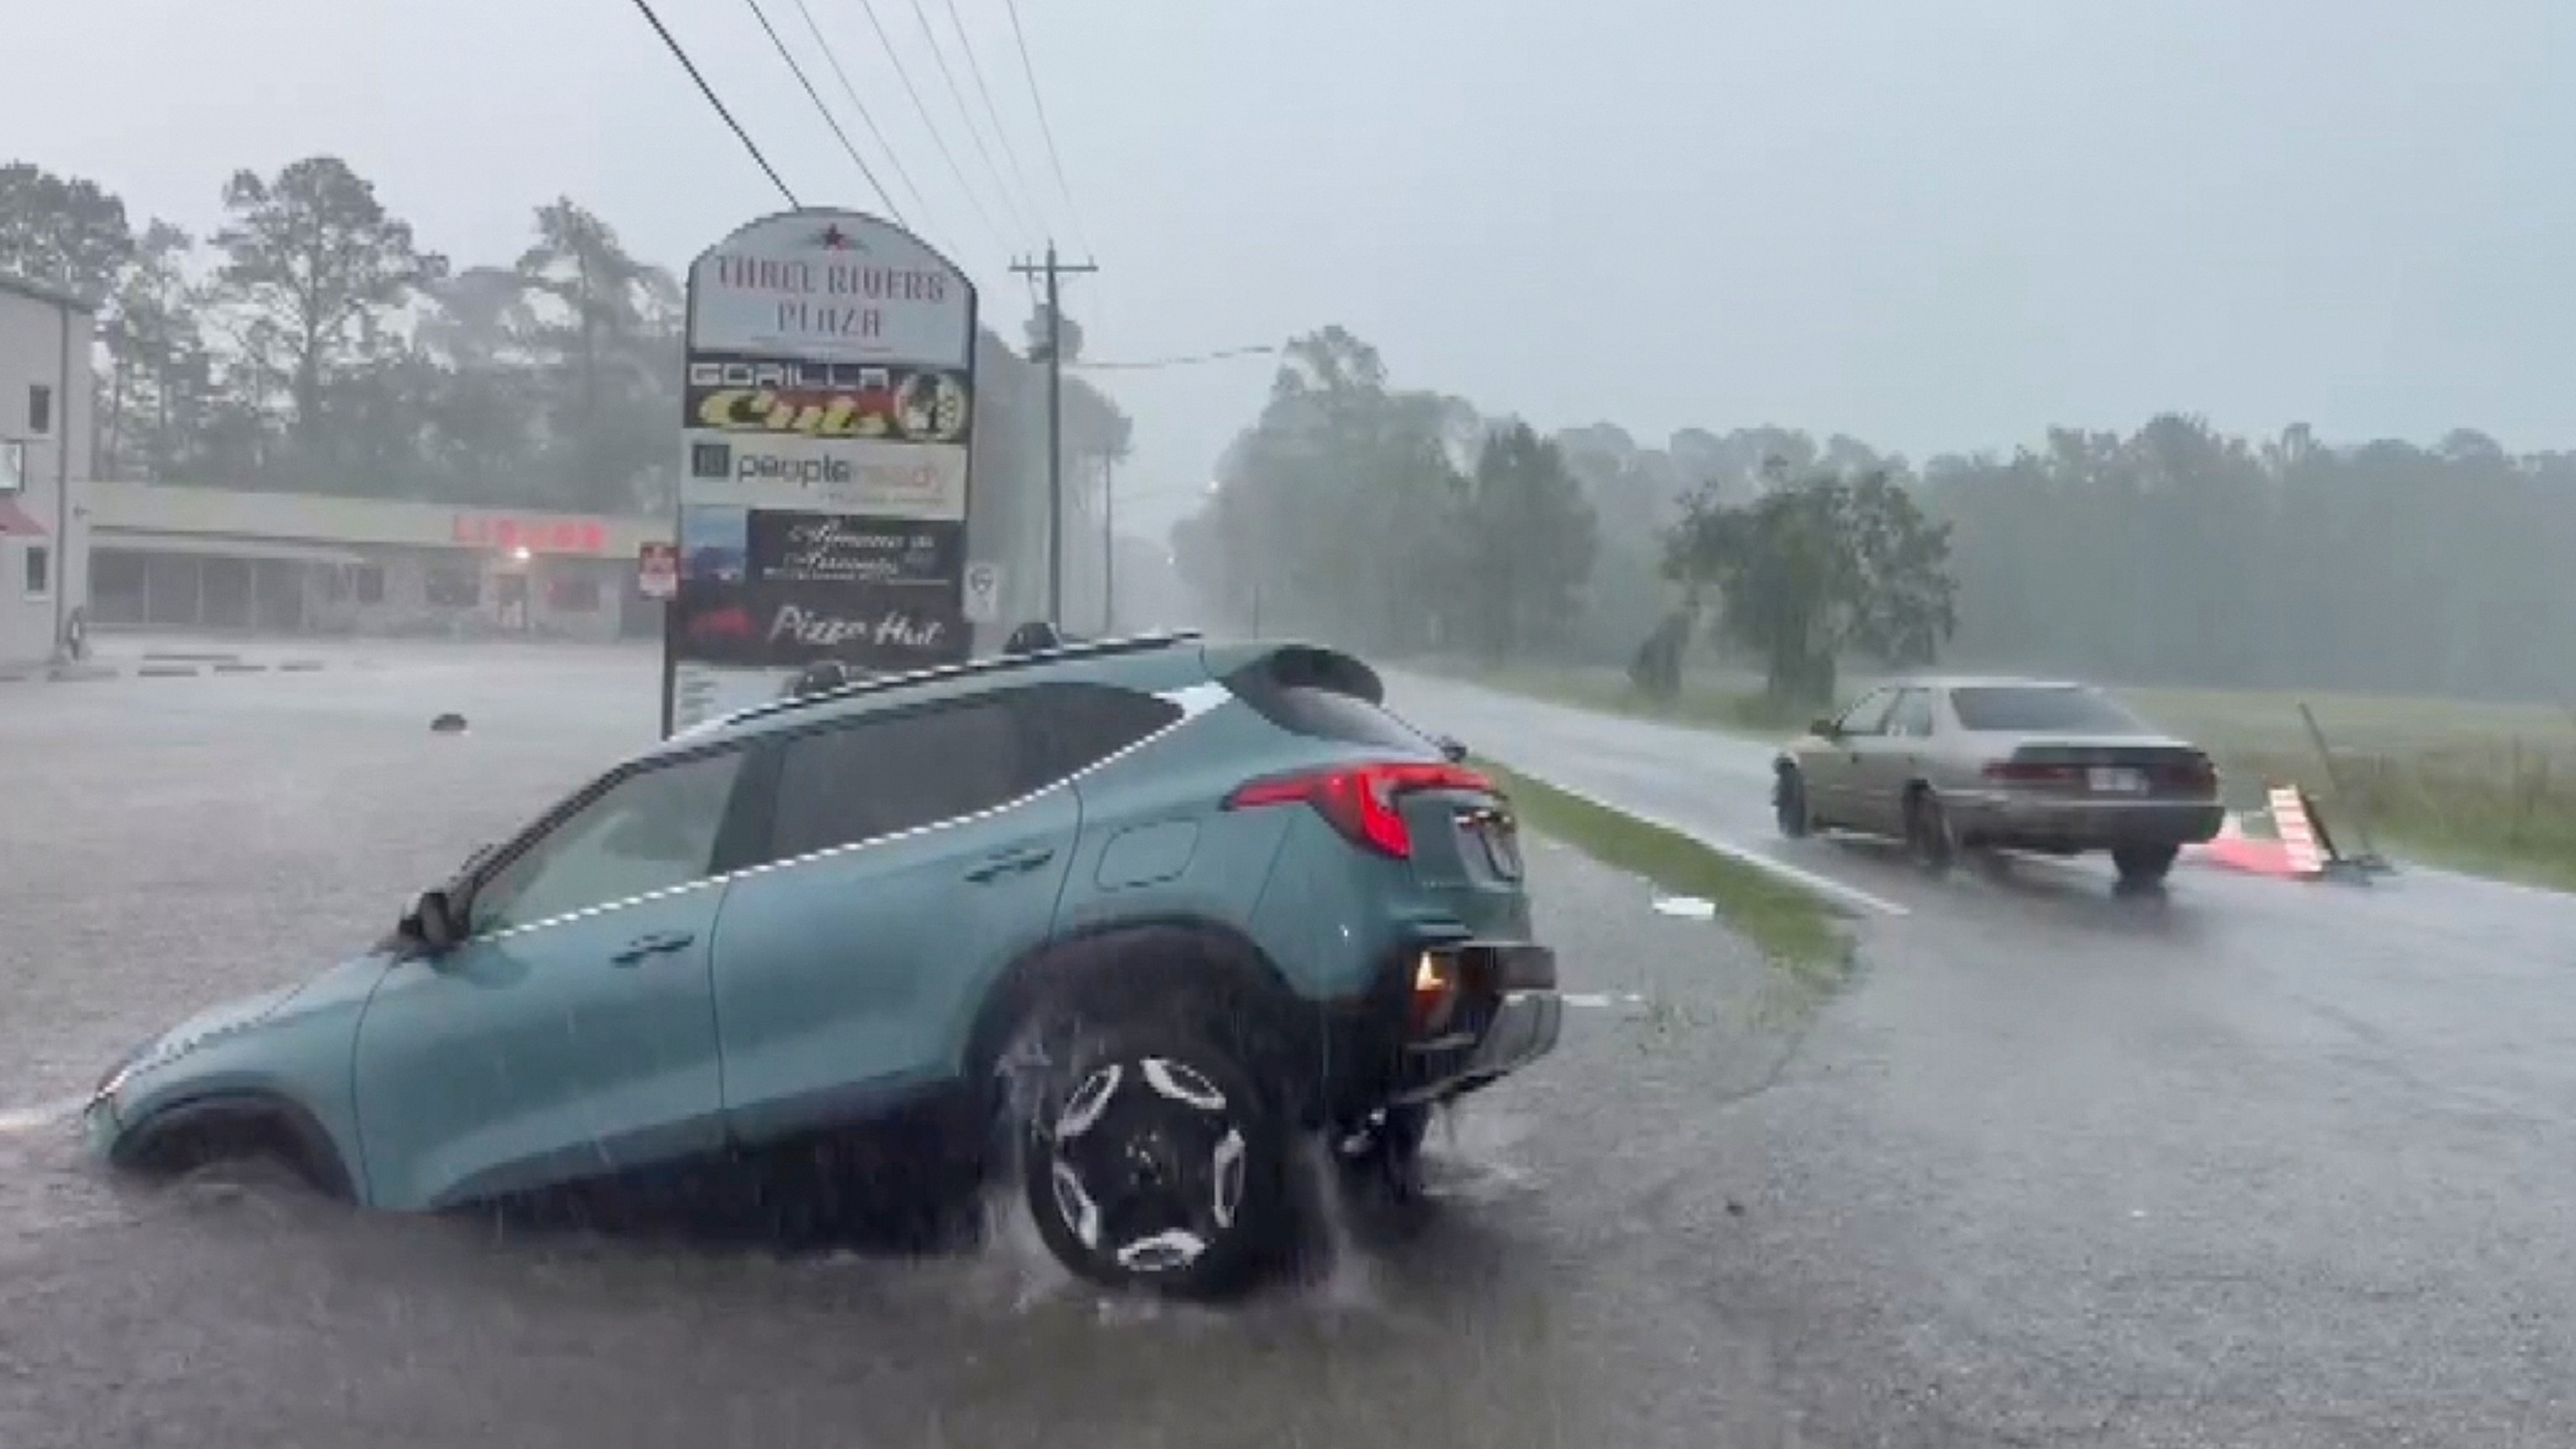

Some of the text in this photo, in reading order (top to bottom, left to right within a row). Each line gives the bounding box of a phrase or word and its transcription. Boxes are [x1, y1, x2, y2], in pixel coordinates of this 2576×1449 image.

[827, 263, 945, 302] RIVERS
[777, 300, 881, 337] PLAZA
[690, 362, 890, 389] GORILLA
[874, 610, 947, 646] Hut
